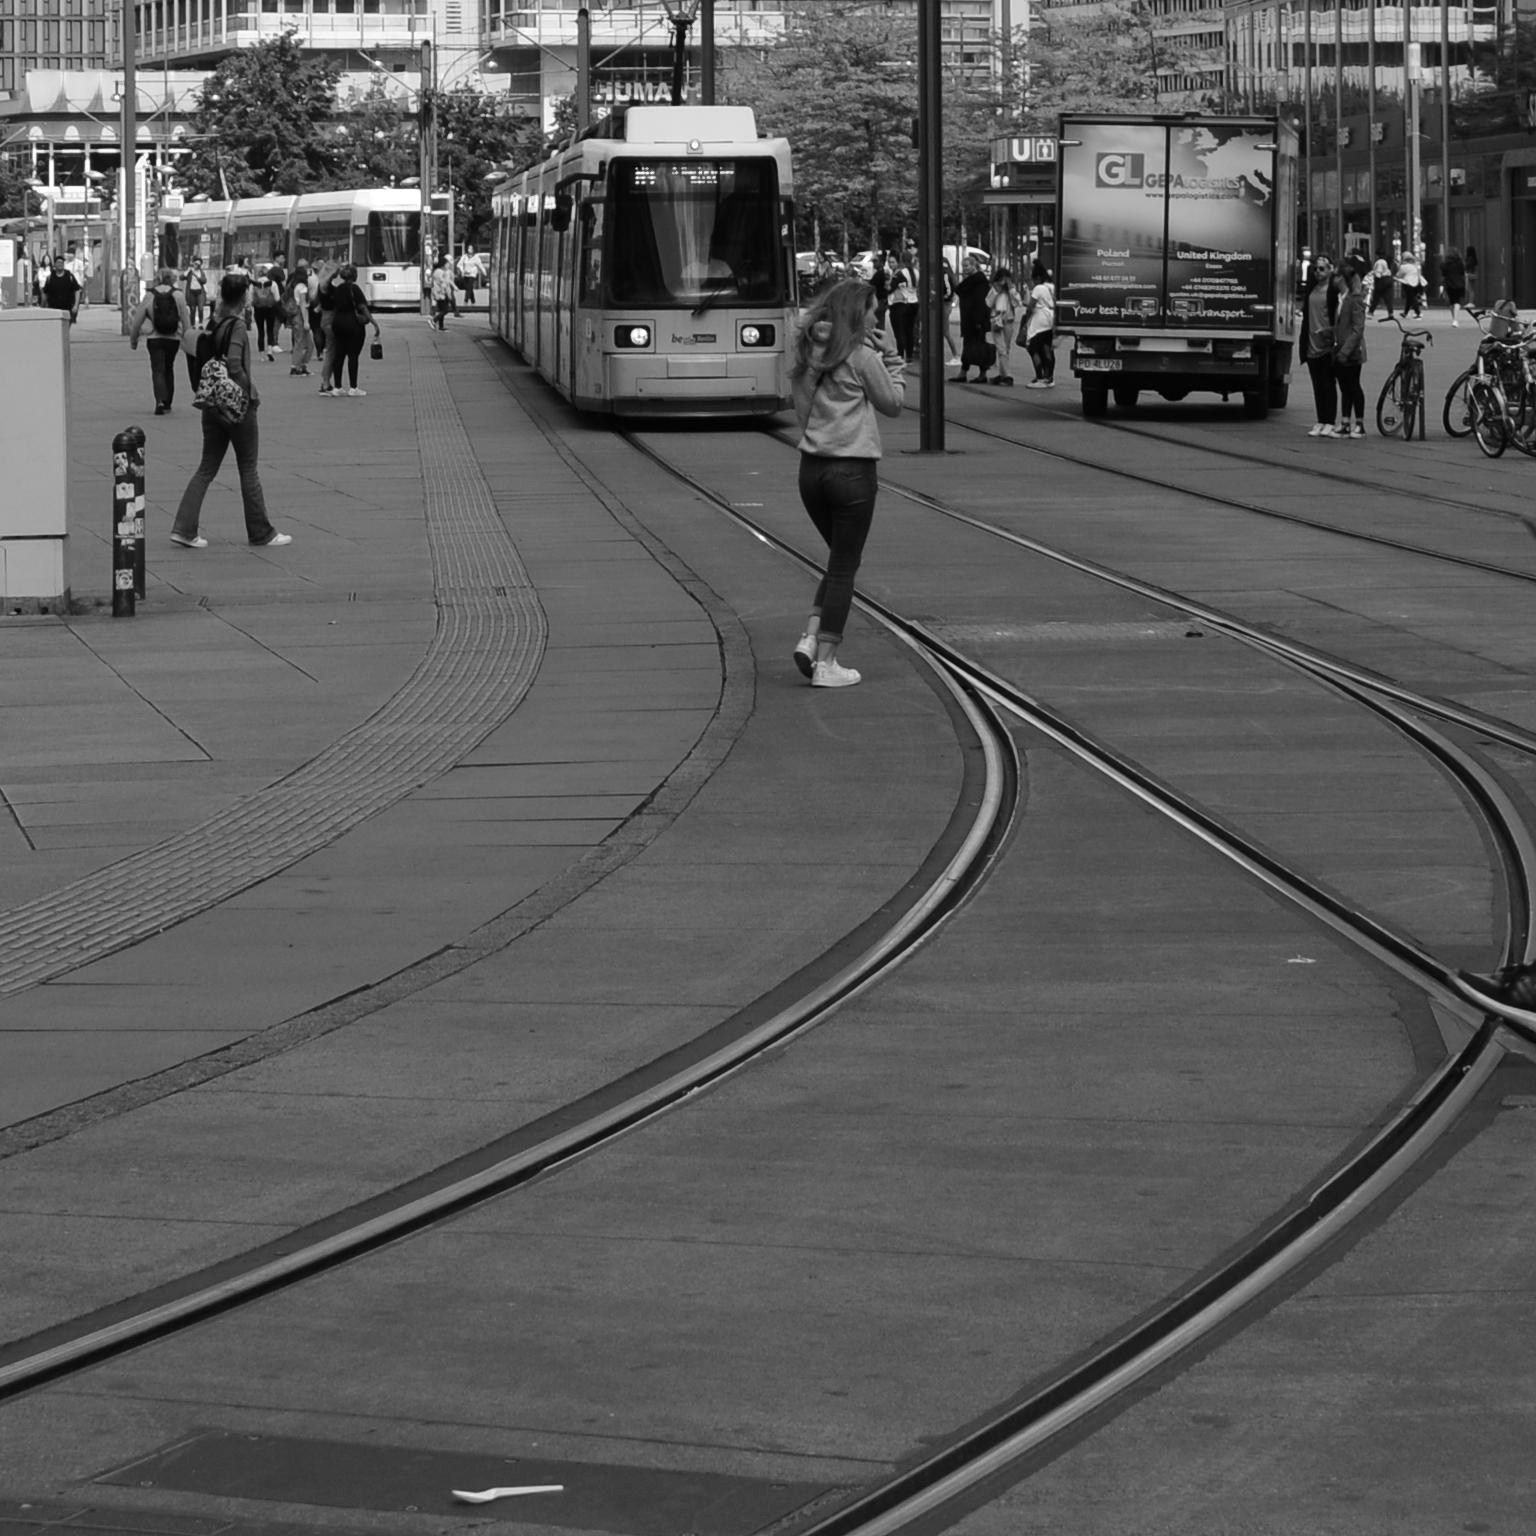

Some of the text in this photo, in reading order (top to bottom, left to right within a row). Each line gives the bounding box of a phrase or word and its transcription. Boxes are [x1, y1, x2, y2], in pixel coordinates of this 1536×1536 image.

[1013, 139, 1030, 161] U
[1098, 155, 1141, 186] GL
[1097, 249, 1130, 258] Poland
[1177, 251, 1252, 262] United Kingdom
[1072, 306, 1097, 317] Your
[1099, 305, 1120, 315] best
